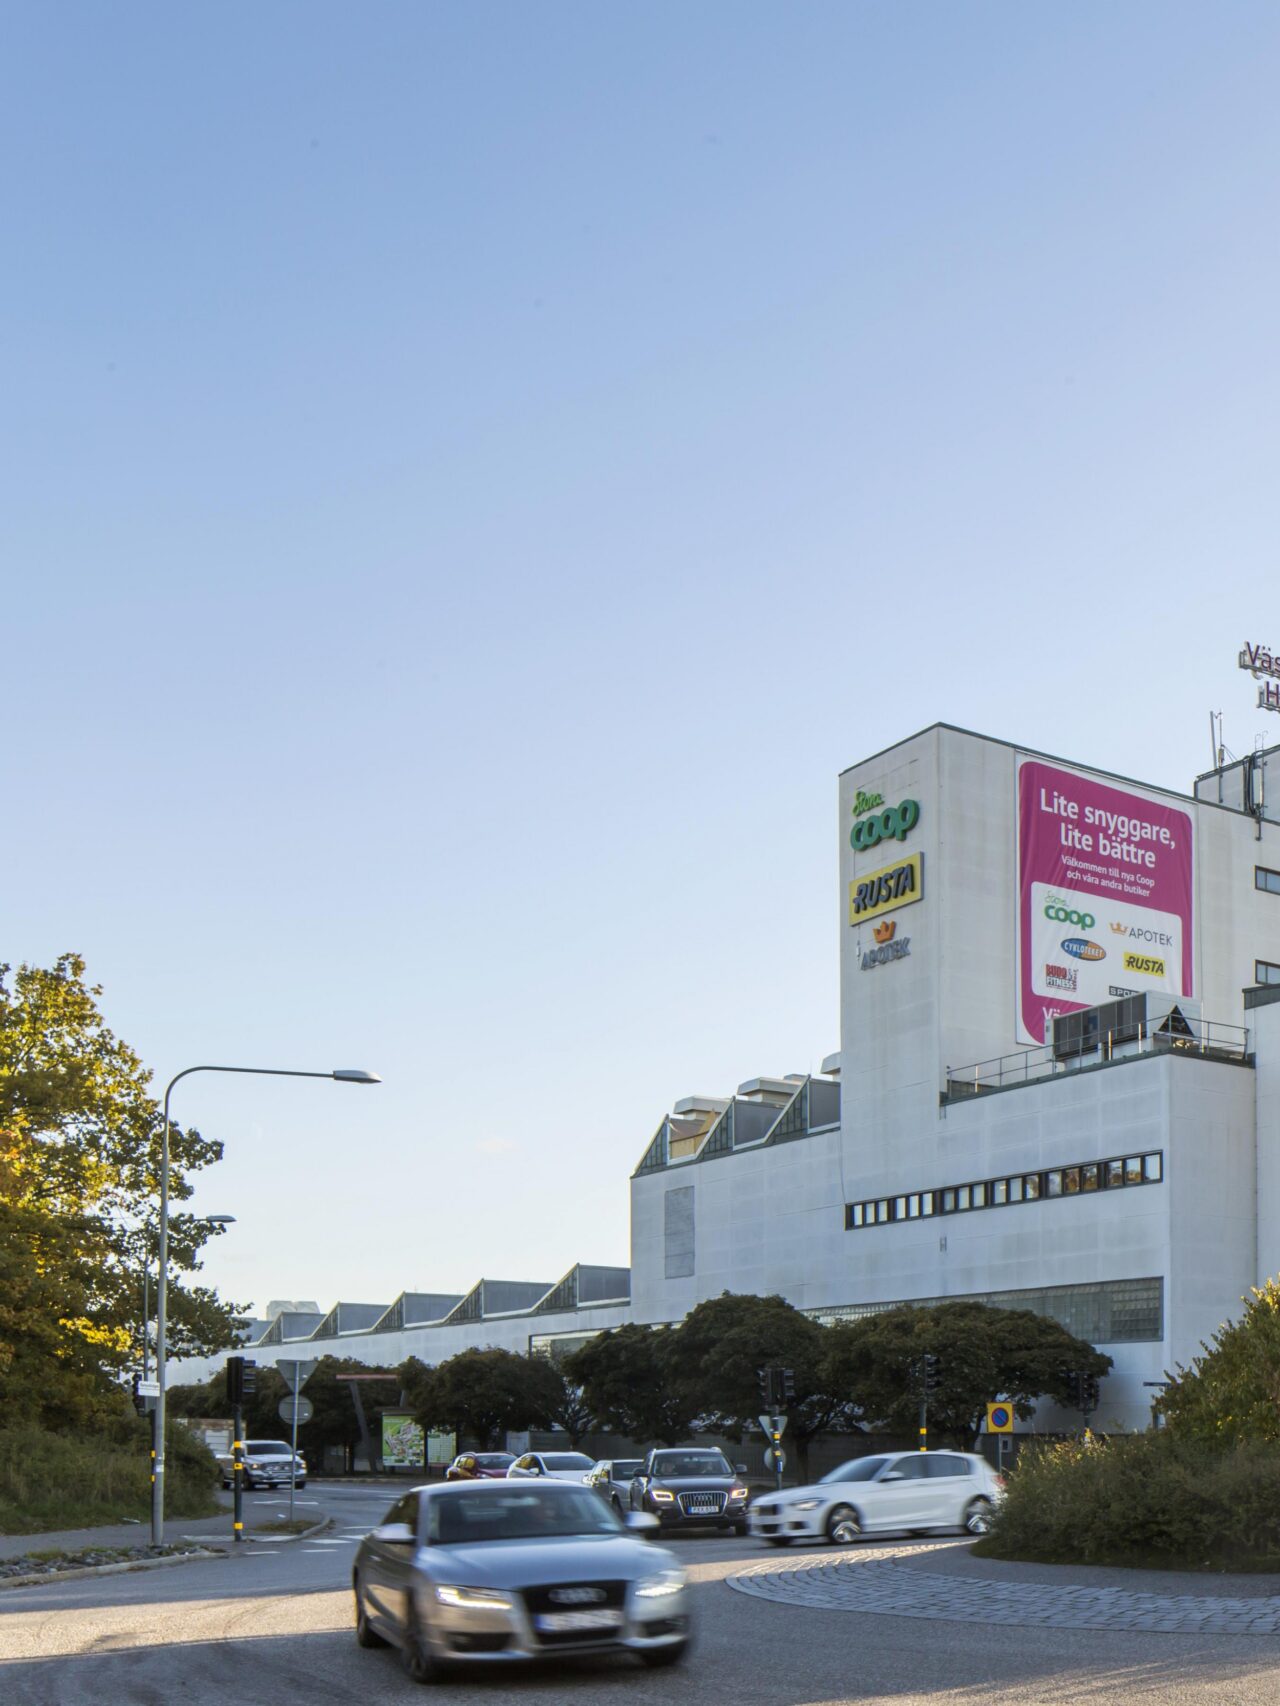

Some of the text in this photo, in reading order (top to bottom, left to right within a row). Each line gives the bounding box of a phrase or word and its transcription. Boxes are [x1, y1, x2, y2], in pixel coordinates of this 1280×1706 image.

[853, 790, 885, 817] Stora
[1040, 788, 1176, 849] Lite snyggare,
[1060, 822, 1156, 868] lite bättre
[1061, 855, 1155, 888] Välkommen till nya Coop
[1066, 870, 1150, 897] och våra andra butiker
[853, 864, 915, 914] RUSTA
[1064, 941, 1104, 958] CYKLOTEKET
[1128, 927, 1173, 947] APOTEK
[860, 937, 911, 971] APOTEK
[1126, 955, 1164, 975] RUSTA
